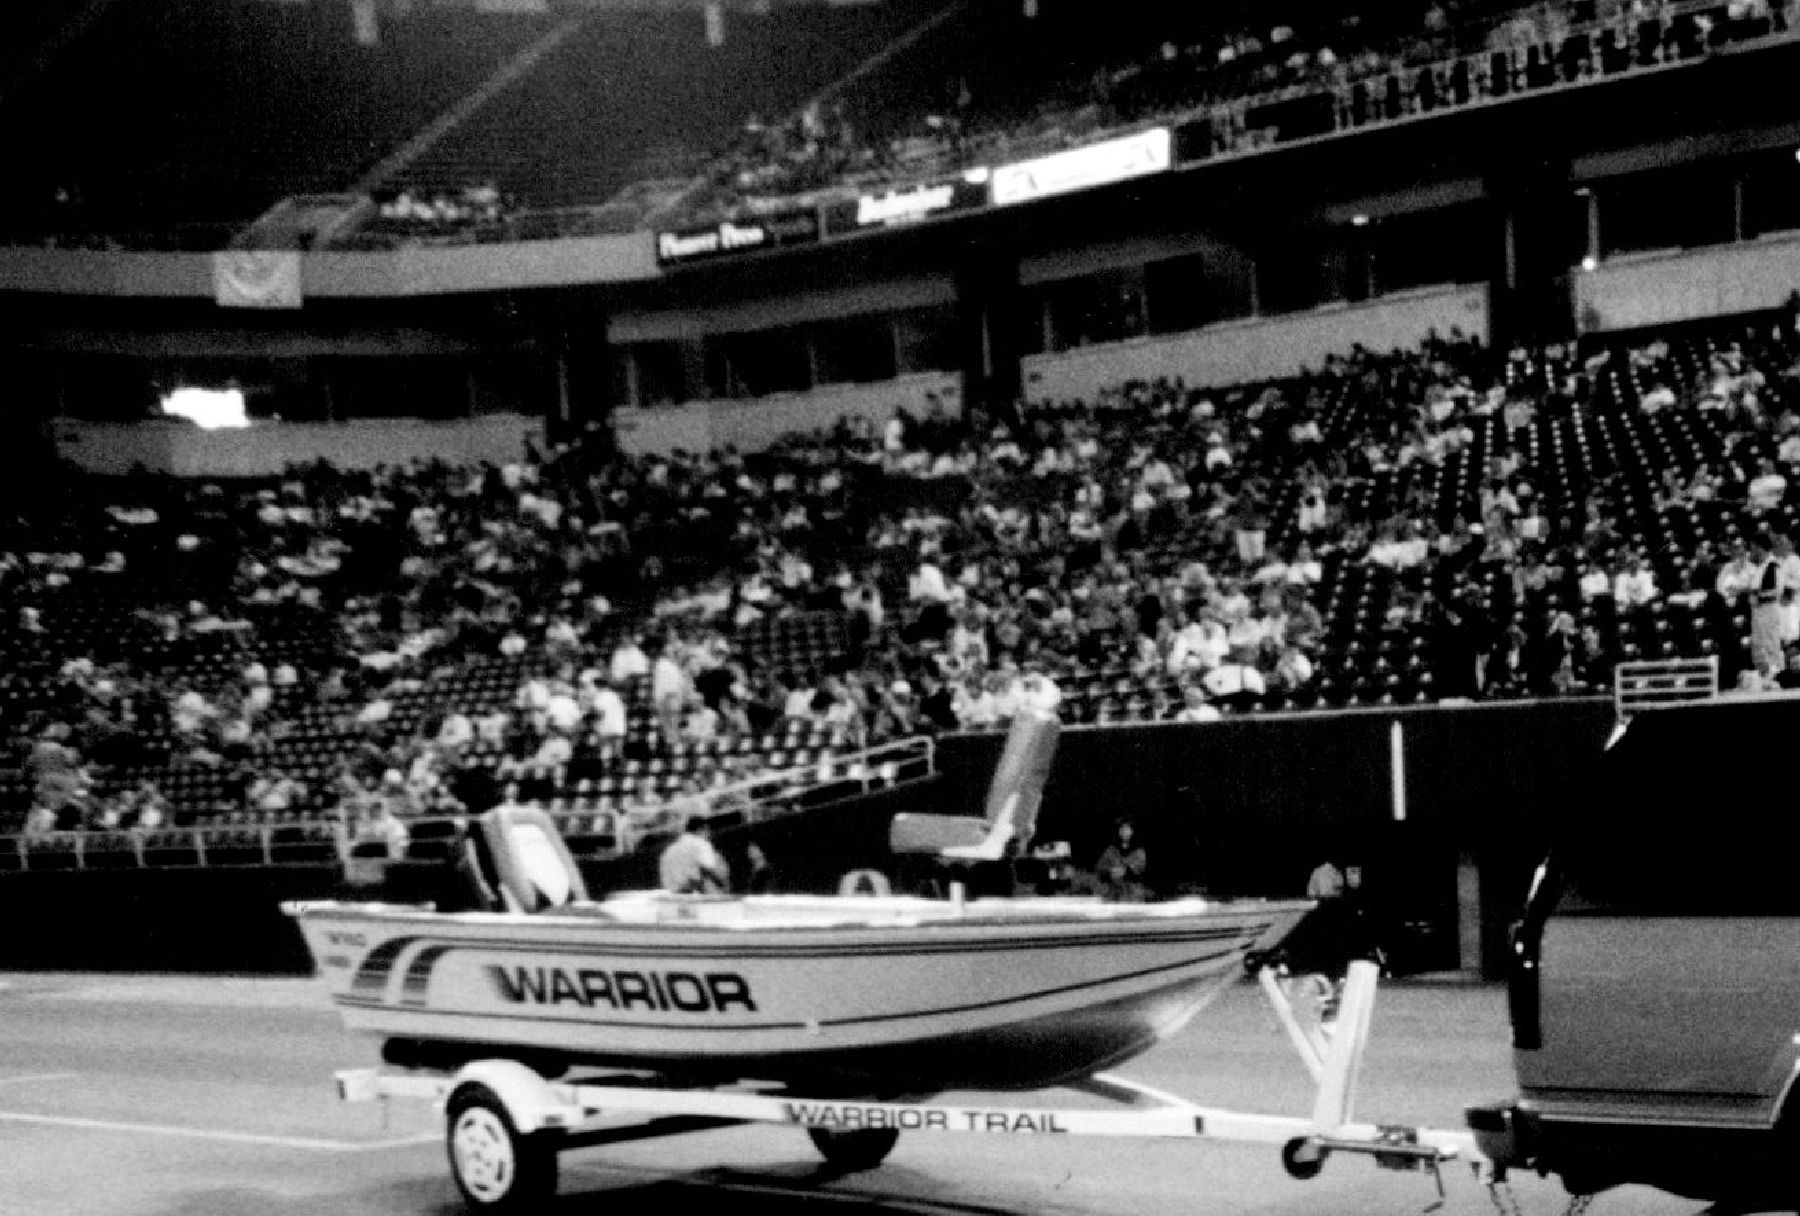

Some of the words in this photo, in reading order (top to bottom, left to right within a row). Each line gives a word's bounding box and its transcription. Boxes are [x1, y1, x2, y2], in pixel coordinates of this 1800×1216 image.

[485, 965, 758, 1013] WARRIOR
[785, 1102, 948, 1131] WARRIOR
[961, 1111, 1069, 1134] TRAIL
